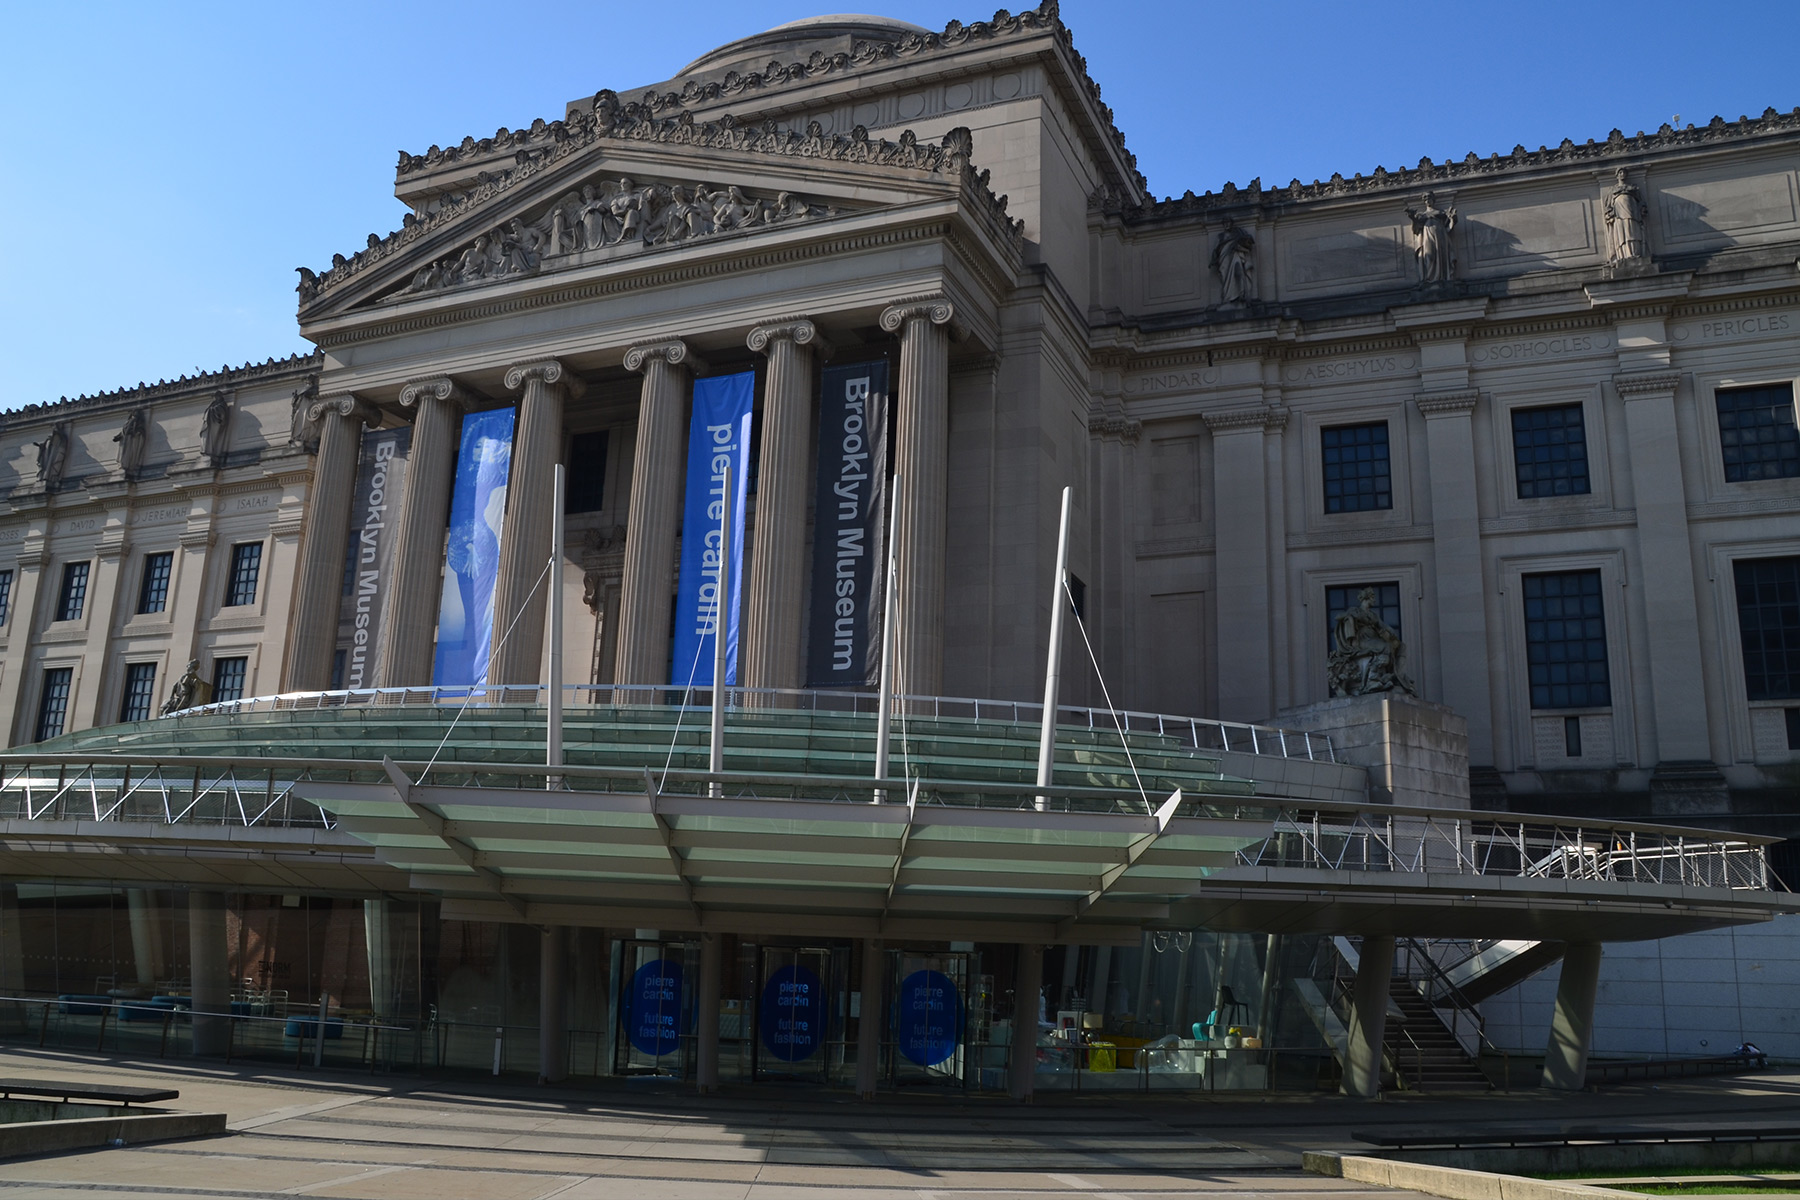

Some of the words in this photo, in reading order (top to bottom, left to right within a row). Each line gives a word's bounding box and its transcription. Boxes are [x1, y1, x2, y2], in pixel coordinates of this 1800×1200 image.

[1702, 315, 1790, 338] PERICLES
[1489, 336, 1592, 360] SOPHOCLES
[1304, 357, 1397, 380] AESCHYLVS
[1141, 373, 1202, 391] PINDAR
[833, 376, 870, 520] Brooklyn
[236, 496, 269, 510] ISAIAH
[360, 440, 396, 564] Brooklyn
[142, 507, 188, 523] JEREMIAH
[70, 519, 96, 532] DAVID
[0, 529, 20, 541] OSES
[832, 528, 864, 671] Museum
[348, 569, 379, 690] Museum
[644, 974, 674, 989] pierre
[780, 981, 809, 995] pierre
[915, 985, 943, 999] pierre
